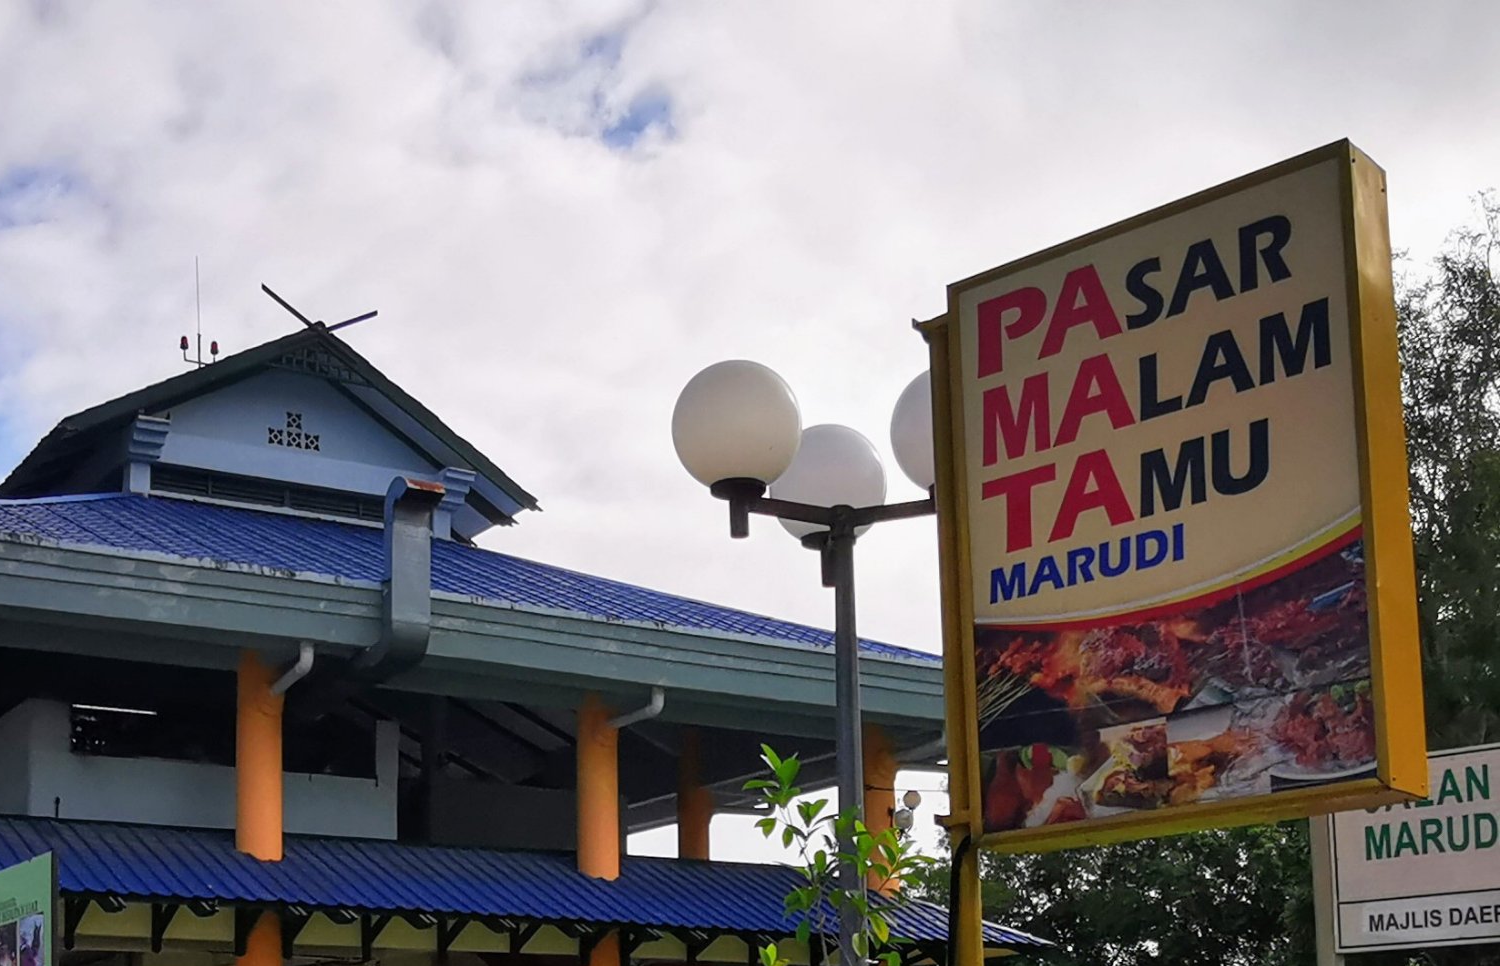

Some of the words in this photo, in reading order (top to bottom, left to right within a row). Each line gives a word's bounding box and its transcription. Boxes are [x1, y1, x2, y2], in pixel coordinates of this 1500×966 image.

[977, 214, 1292, 379] PASAR
[982, 297, 1331, 467] MALAM
[982, 418, 1270, 554] TAMU
[990, 523, 1185, 604] MARUDI
[1369, 909, 1442, 932] MAJLIS
